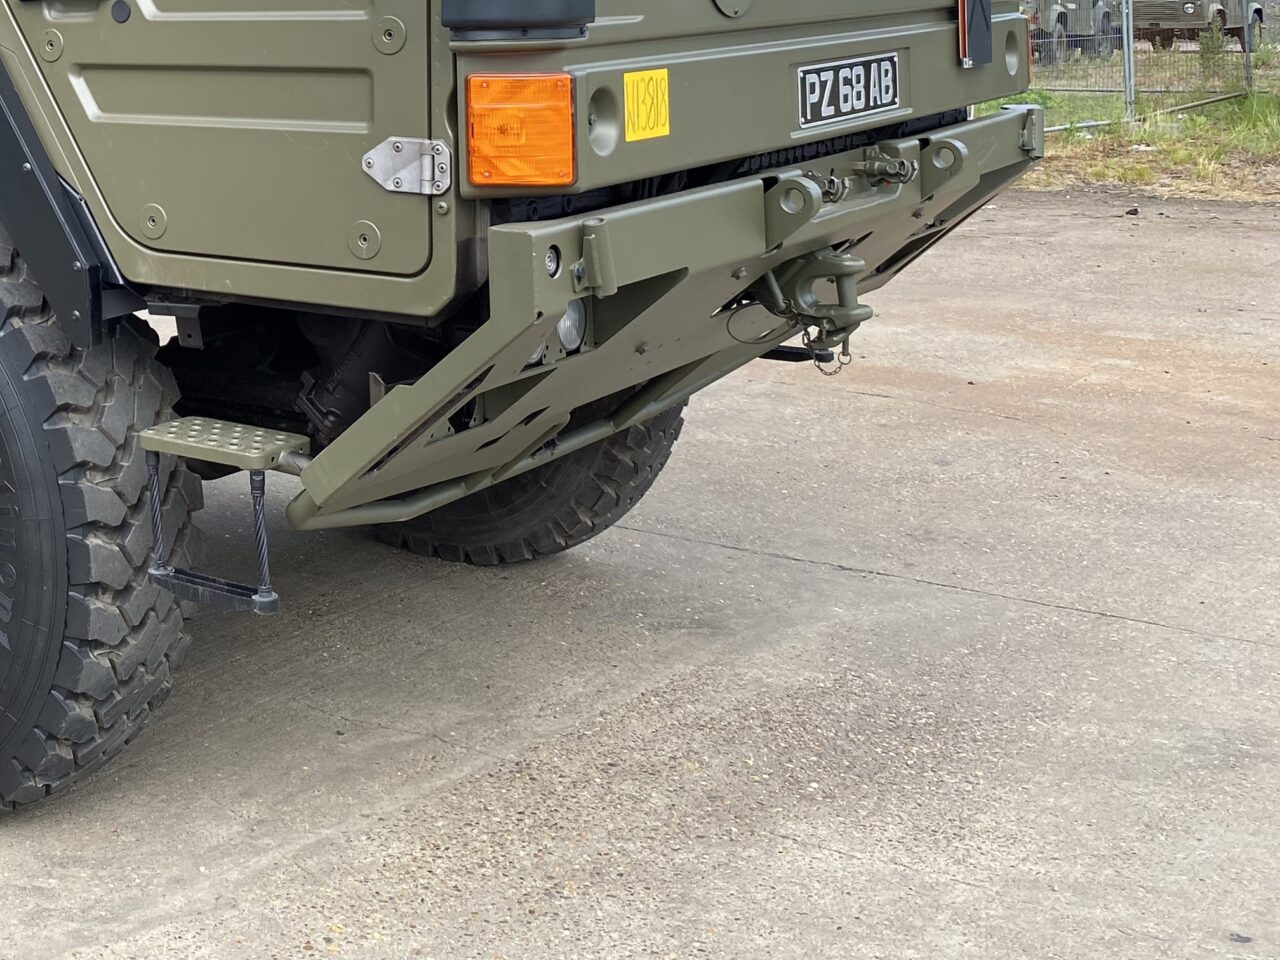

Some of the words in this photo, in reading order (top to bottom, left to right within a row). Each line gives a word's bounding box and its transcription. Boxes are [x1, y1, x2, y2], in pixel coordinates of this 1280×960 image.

[805, 70, 835, 120] PZ
[839, 65, 866, 113] 68
[869, 60, 894, 107] AB
